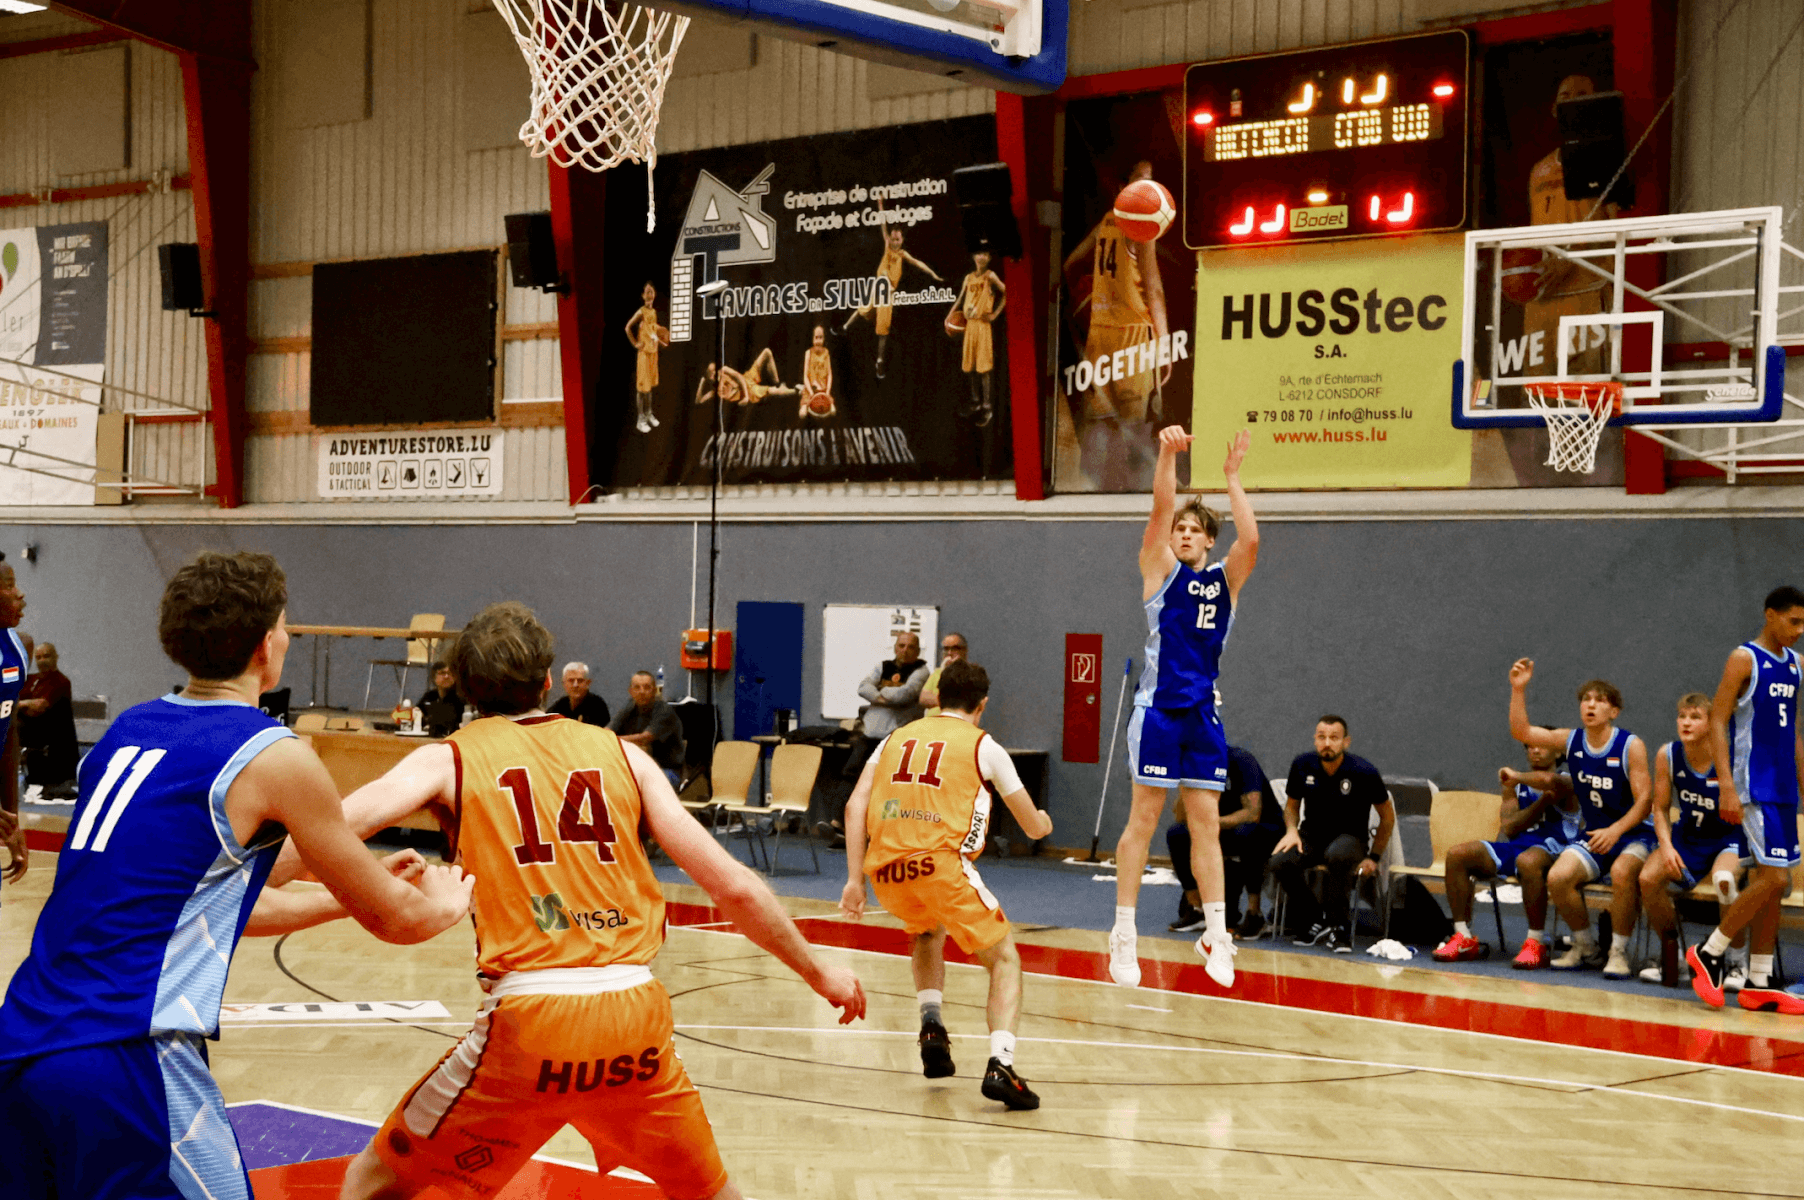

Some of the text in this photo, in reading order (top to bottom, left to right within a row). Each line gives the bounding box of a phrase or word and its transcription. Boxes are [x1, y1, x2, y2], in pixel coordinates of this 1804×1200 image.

[784, 178, 947, 210] Entreprise de construction
[684, 222, 741, 236] CONSTRUCTIONS
[796, 211, 843, 235] Façade
[845, 211, 860, 228] et
[1294, 211, 1344, 229] Bodet
[808, 298, 823, 312] DA
[823, 276, 892, 311] SILVA
[1221, 287, 1448, 340] HUSStec
[1314, 344, 1347, 359] S.A.
[1499, 330, 1545, 374] WE
[1064, 330, 1189, 396] TOGETHER
[0, 378, 86, 406] ENGLER
[1298, 377, 1312, 386] rte
[1279, 387, 1382, 401] L-6212 CONSDORF
[1705, 387, 1757, 401] Schelde
[0, 417, 78, 430] AUX DOMAINES
[1263, 410, 1277, 422] 79
[1281, 410, 1295, 421] 08
[1299, 409, 1313, 421] 70
[1327, 407, 1413, 423] info@huss.lu
[330, 435, 491, 456] ADVENTURESTORE.LU
[1273, 427, 1387, 443] www.huss.lu
[329, 461, 371, 476] OUTDOOR
[335, 478, 371, 491] TACTICAL
[1196, 603, 1217, 629] 12
[1778, 703, 1788, 727] 5
[891, 737, 947, 790] 11
[70, 745, 168, 853] 11
[1590, 790, 1603, 808] 9
[497, 767, 618, 868] 14
[1691, 810, 1705, 827] 7
[876, 857, 935, 883] HUSS
[536, 1047, 661, 1094] HUSS
